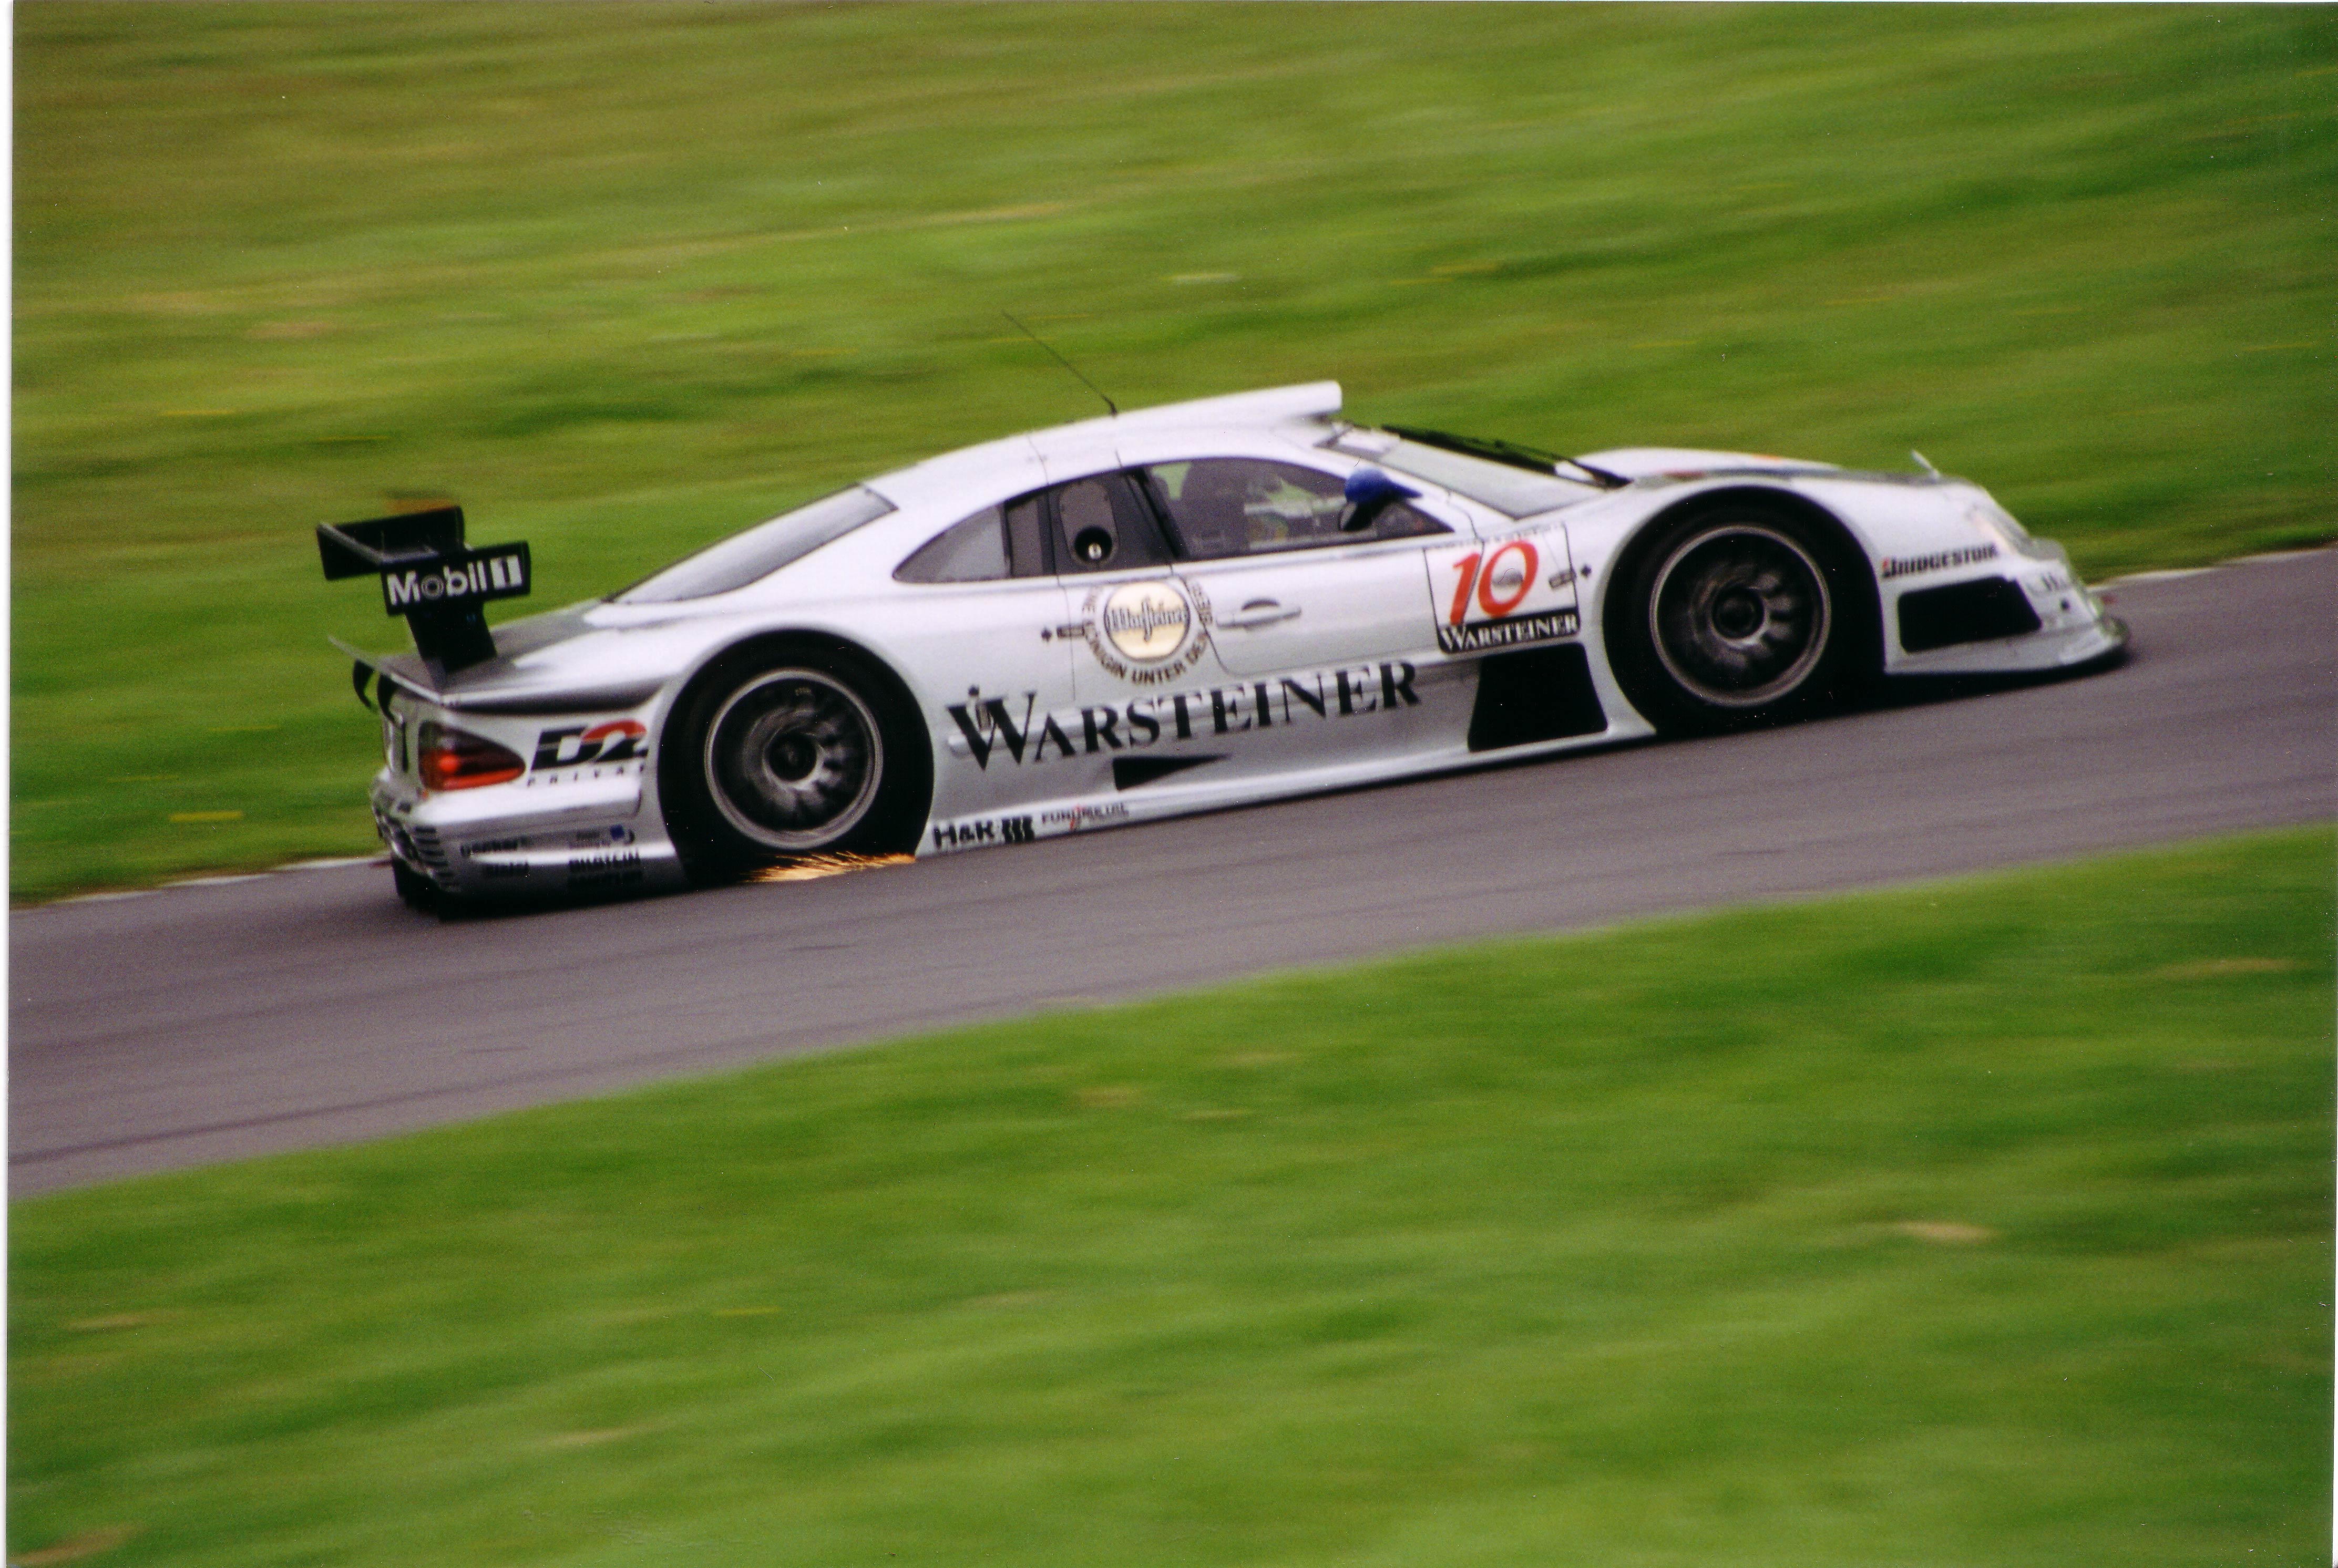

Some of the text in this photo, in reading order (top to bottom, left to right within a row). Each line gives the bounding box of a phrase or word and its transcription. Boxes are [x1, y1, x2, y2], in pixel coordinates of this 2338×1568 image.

[387, 559, 488, 606] Mobil
[1449, 540, 1539, 625] 10
[1440, 613, 1578, 652] WARSTEINER
[1131, 659, 1187, 684] UNTER
[948, 661, 1420, 770] WARSTEINER
[530, 718, 649, 771] D2
[934, 820, 994, 849] H&K
